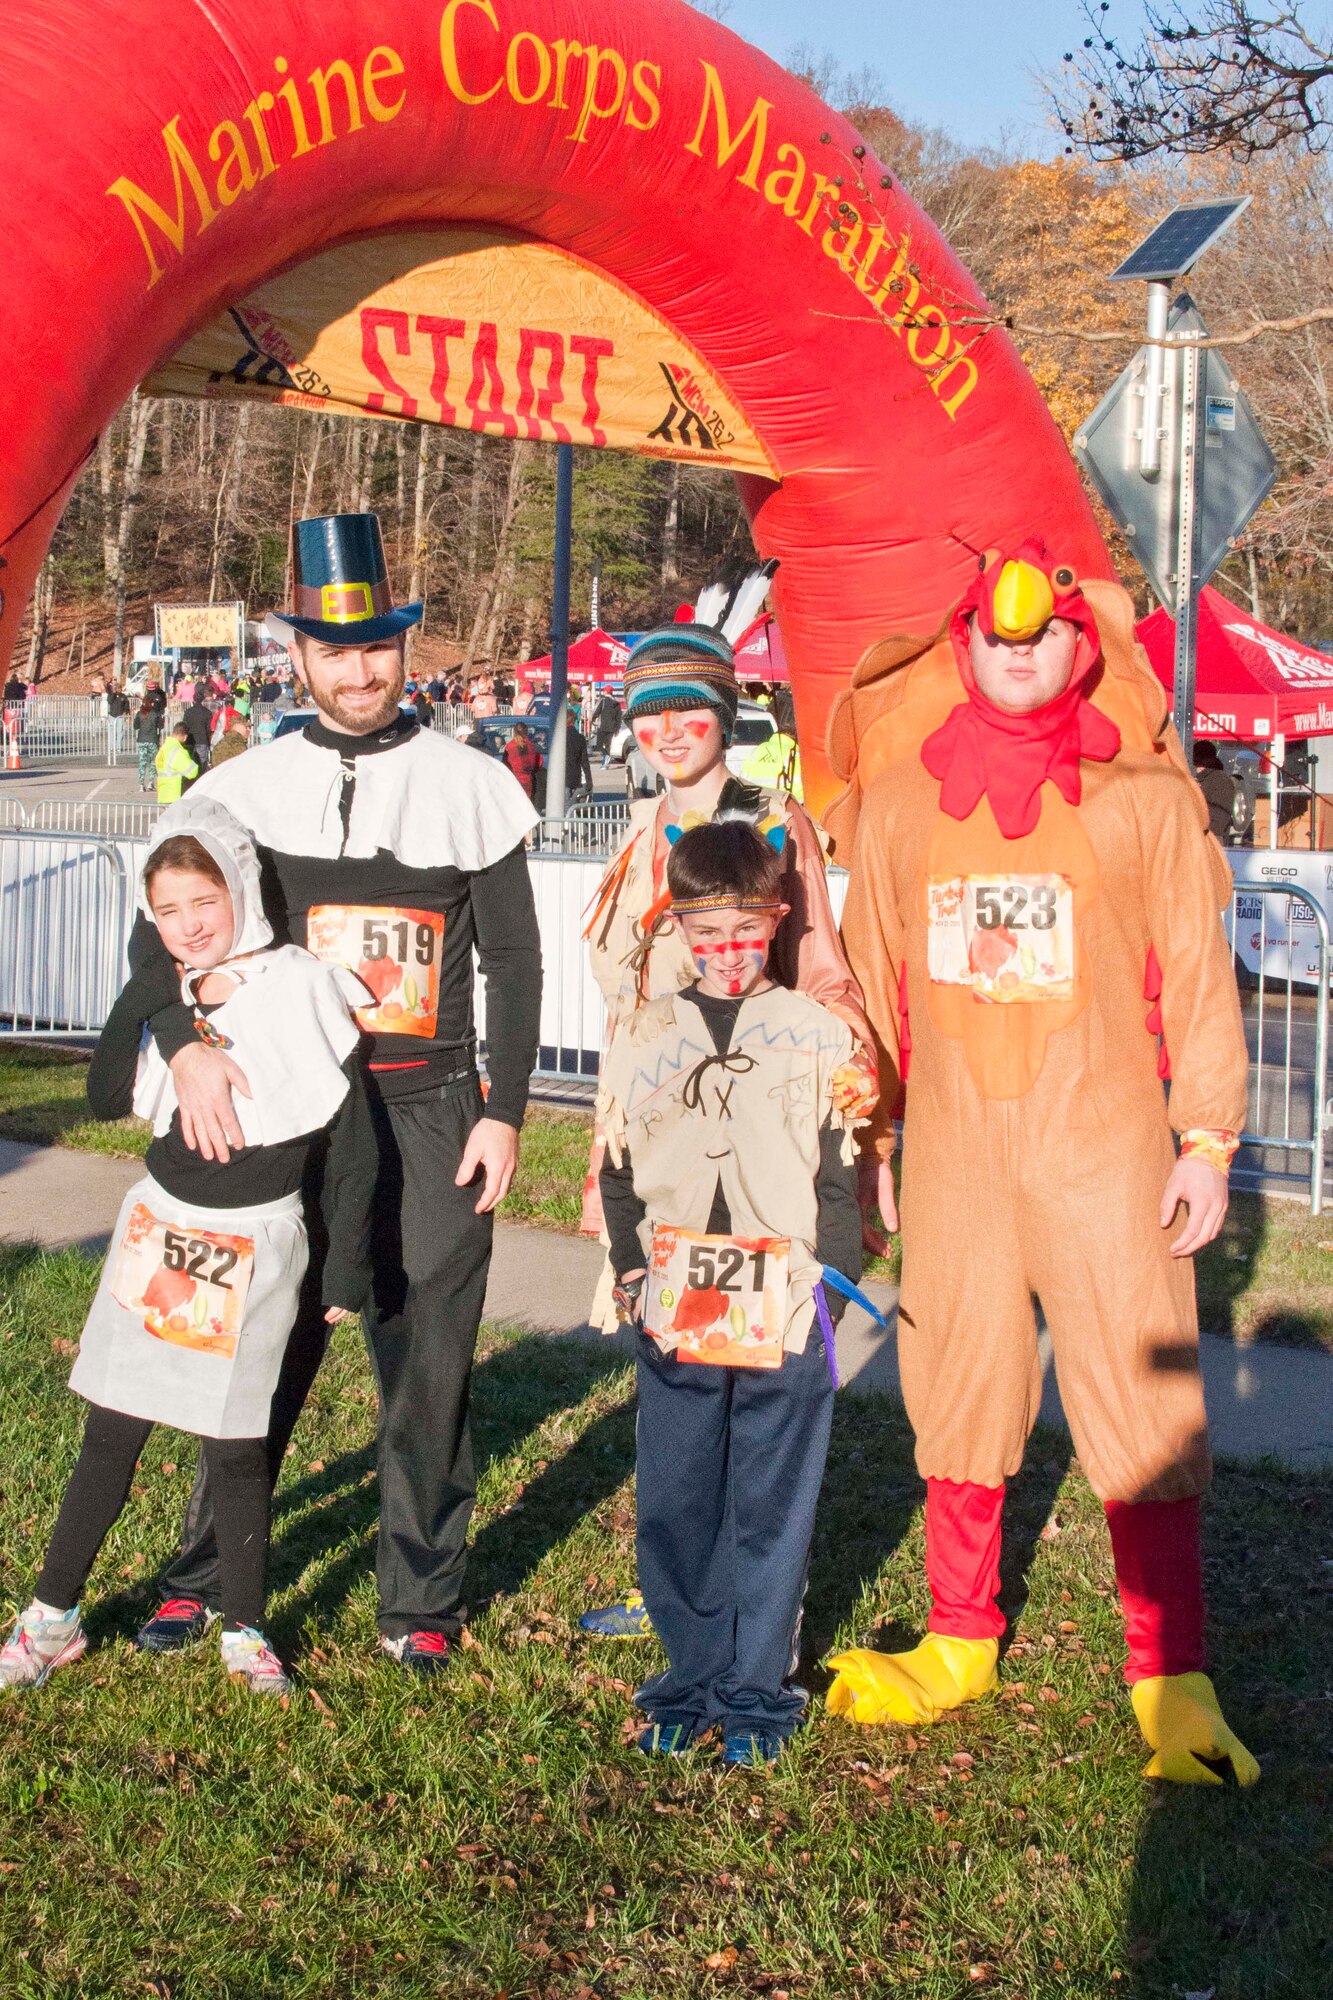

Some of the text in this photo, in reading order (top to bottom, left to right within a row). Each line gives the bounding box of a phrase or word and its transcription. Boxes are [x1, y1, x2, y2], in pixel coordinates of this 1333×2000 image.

[105, 0, 979, 422] Marine Corps Marathon
[360, 307, 614, 449] START
[681, 375, 711, 420] MCM
[271, 652, 291, 665] CORPS
[1261, 867, 1298, 876] GEICO
[976, 885, 1057, 930] 523
[363, 919, 435, 966] 519
[163, 1229, 238, 1290] 522
[687, 1245, 766, 1292] 521
